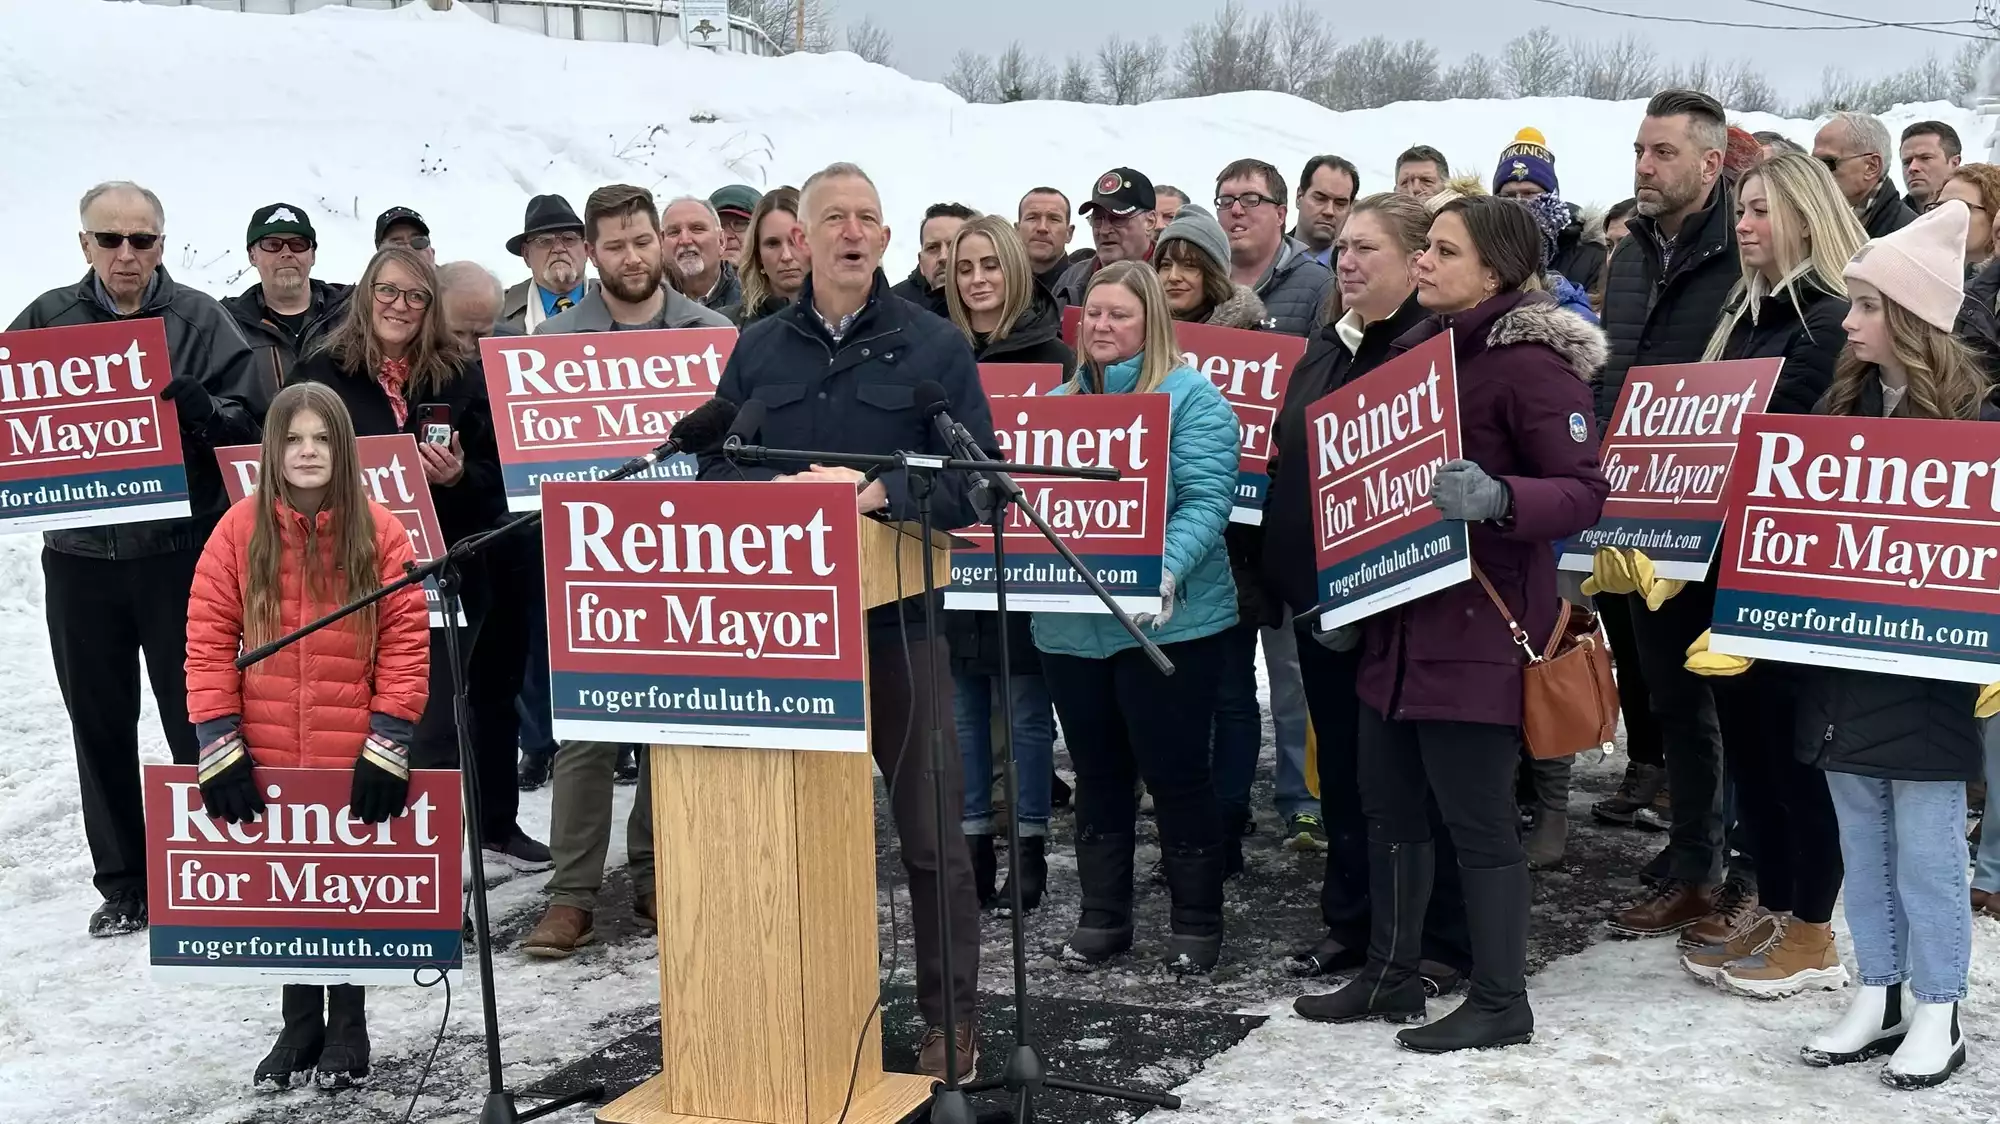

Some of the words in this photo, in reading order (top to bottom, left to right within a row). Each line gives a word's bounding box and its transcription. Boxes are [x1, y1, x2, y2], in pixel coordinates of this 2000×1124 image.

[1502, 144, 1551, 163] VIKINGS
[0, 338, 152, 402] inert
[498, 343, 723, 396] Reinert
[520, 408, 582, 442] for
[592, 403, 696, 441] May
[1313, 360, 1444, 479] Reinert
[1613, 378, 1757, 437] Reinert
[5, 414, 150, 460] Mayor
[994, 411, 1148, 470] inert
[0, 478, 163, 508] forduluth.com
[1605, 452, 1639, 492] for
[1638, 453, 1725, 504] Mayor
[561, 500, 836, 577] Reinert
[1010, 488, 1139, 539] Mayor
[1325, 493, 1357, 539] for
[1579, 527, 1702, 549] rogerforduluth.com
[1329, 534, 1451, 597] rogerforduluth.com
[1748, 517, 1818, 567] for
[1830, 522, 1997, 589] Mayor
[577, 592, 647, 643] for
[661, 595, 828, 660] Mayor
[1736, 604, 1989, 648] rogerforduluth.com
[578, 685, 835, 715] rogerforduluth.com
[178, 860, 251, 902] for
[266, 862, 430, 914] Mayor
[178, 936, 433, 960] rogerforduluth.com
